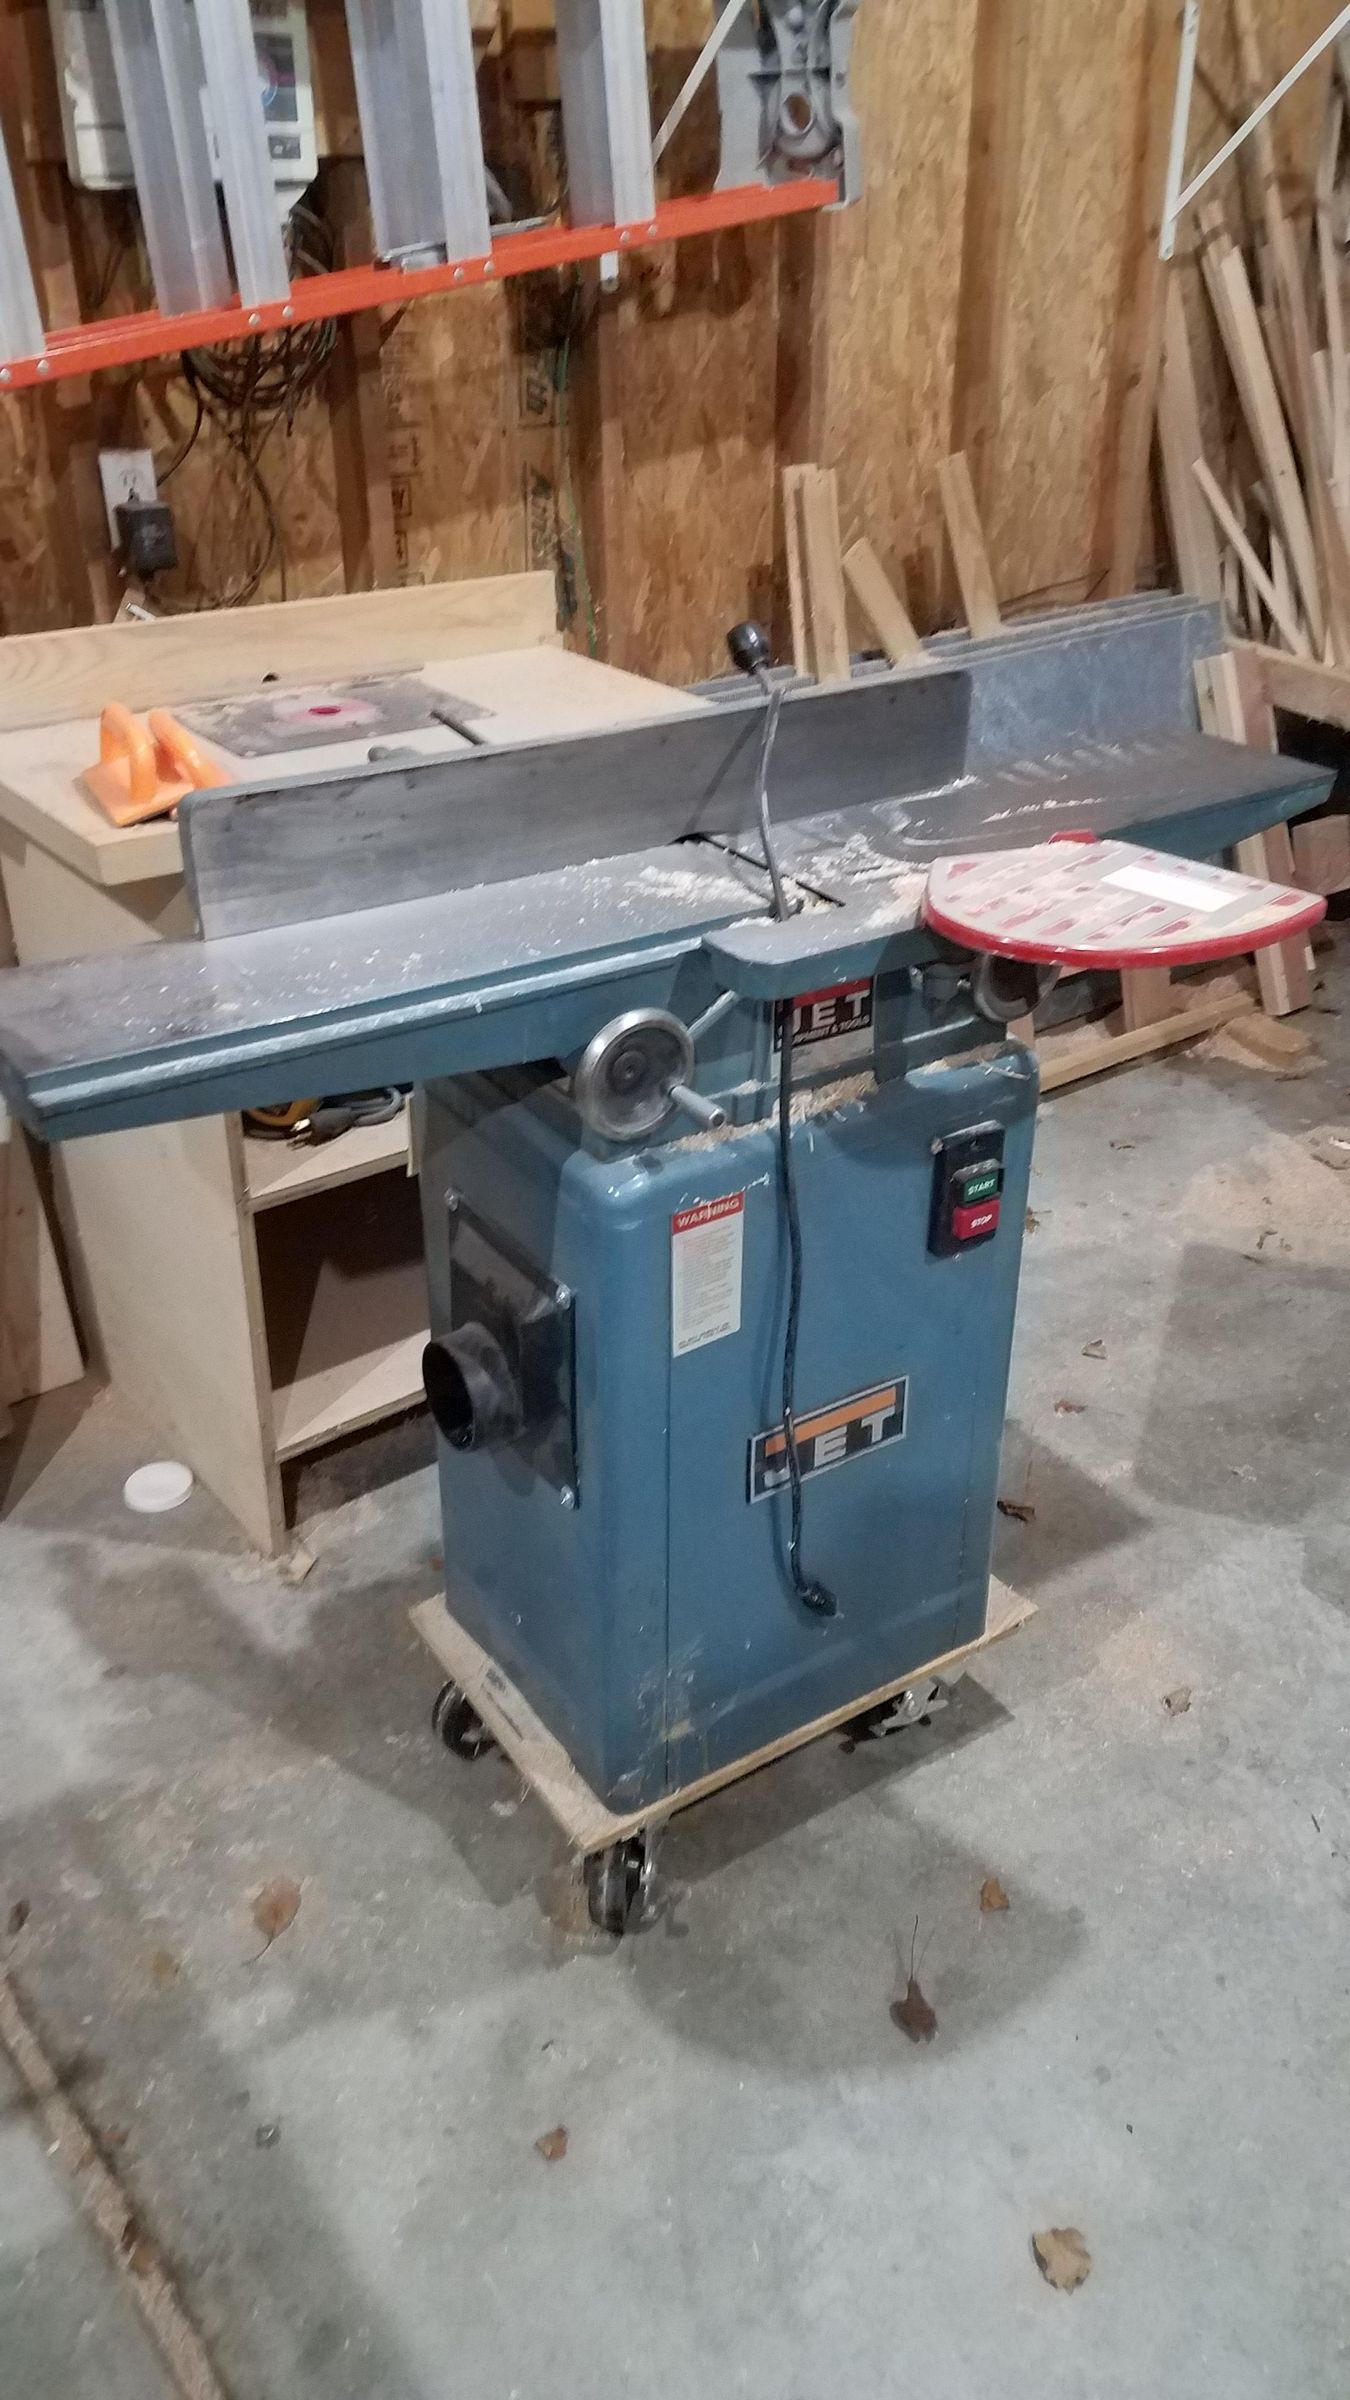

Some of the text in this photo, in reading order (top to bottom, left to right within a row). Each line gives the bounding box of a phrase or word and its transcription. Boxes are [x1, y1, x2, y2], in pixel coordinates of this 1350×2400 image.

[967, 1178, 996, 1196] START
[677, 1198, 740, 1228] WARNING
[970, 1213, 993, 1229] STOP
